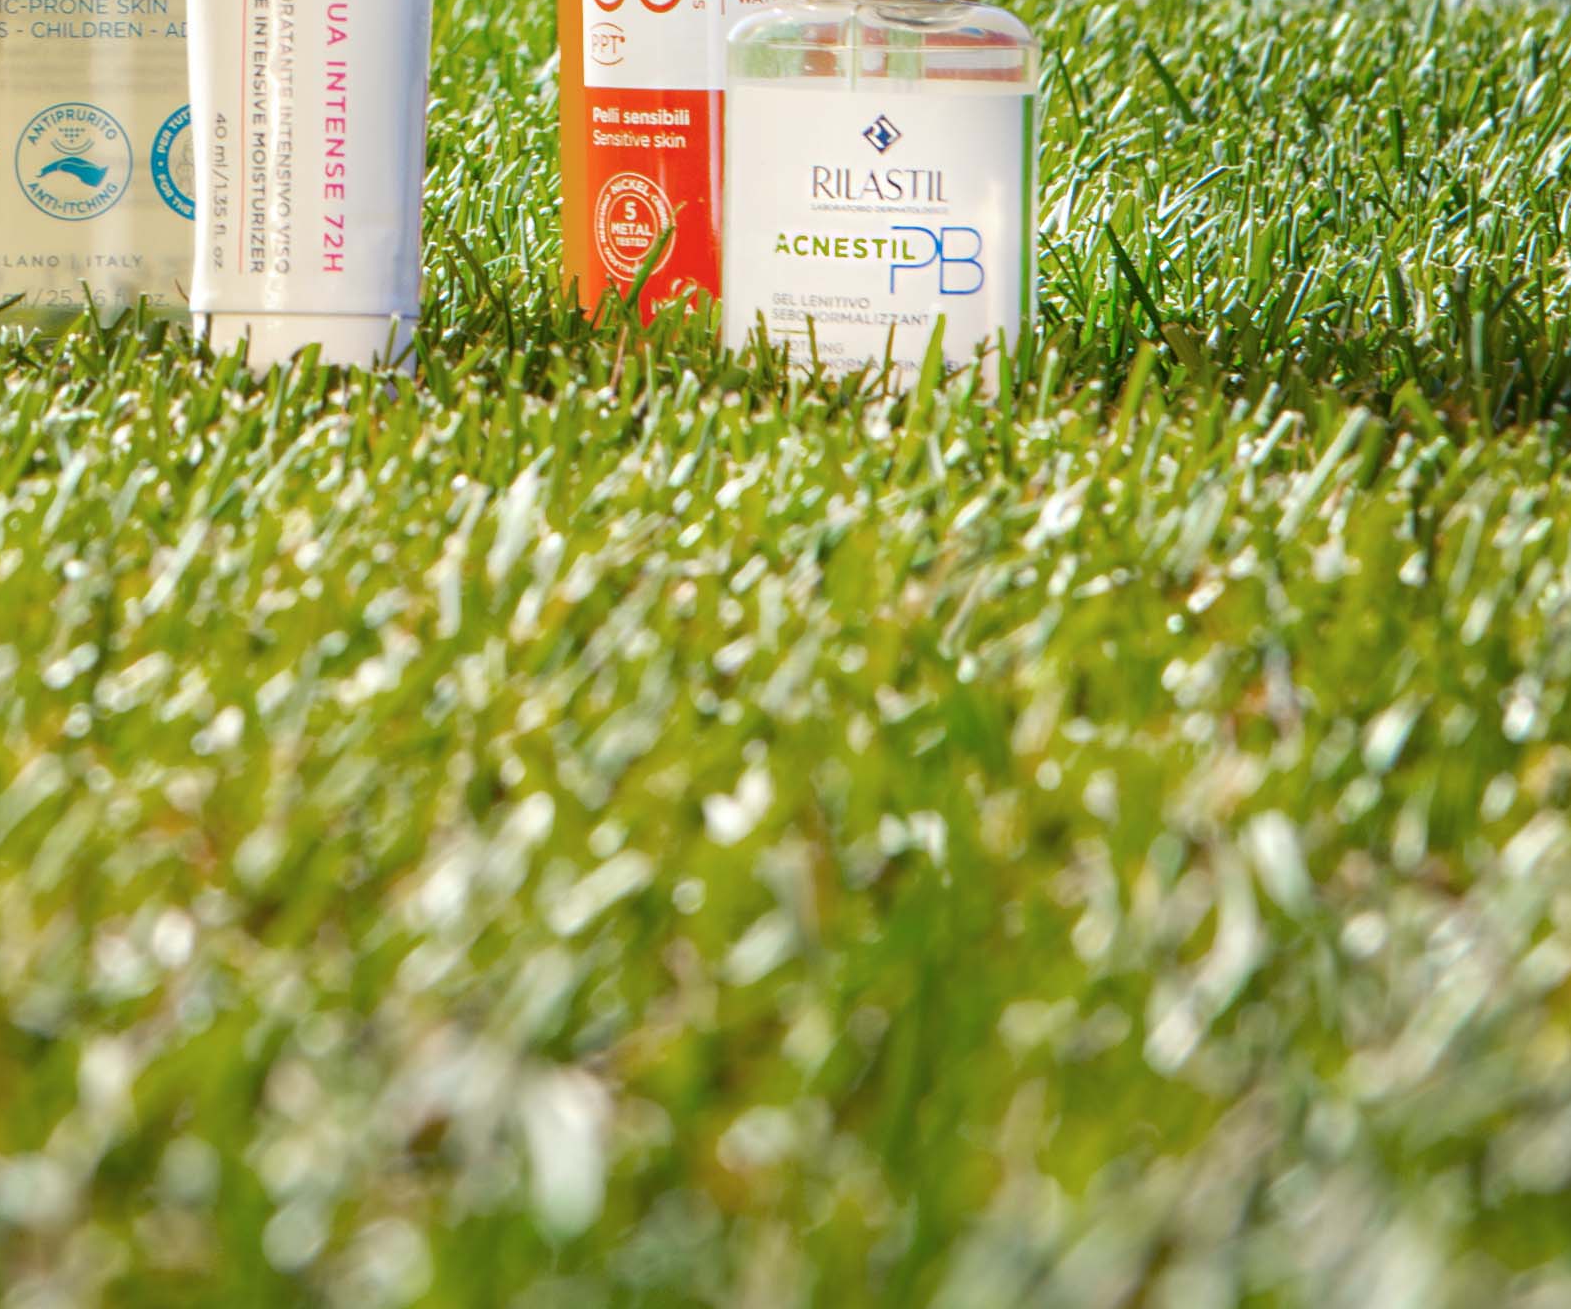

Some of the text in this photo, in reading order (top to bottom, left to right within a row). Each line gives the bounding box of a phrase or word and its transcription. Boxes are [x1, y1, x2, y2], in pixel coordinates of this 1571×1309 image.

[31, 22, 143, 38] CHILDREN
[251, 16, 268, 125] INTENSIVE
[27, 109, 118, 145] ANTIPRURITO
[215, 113, 227, 138] 40
[324, 61, 347, 199] INTENSE
[592, 106, 690, 126] Pelli sensibili
[592, 130, 686, 148] Sensitive skin
[276, 106, 293, 217] INTENSIVO
[27, 182, 118, 213] ANTI-ITCHING
[610, 178, 650, 197] NICKEL
[812, 165, 948, 203] RILASTIL
[249, 132, 266, 273] MOISTURIZER
[323, 215, 344, 273] 72H
[611, 223, 653, 236] METAL
[275, 225, 290, 274] VISO
[774, 233, 916, 260] ACNESTIL
[86, 255, 143, 268] ITALY
[772, 293, 870, 309] GEL LENITIVO
